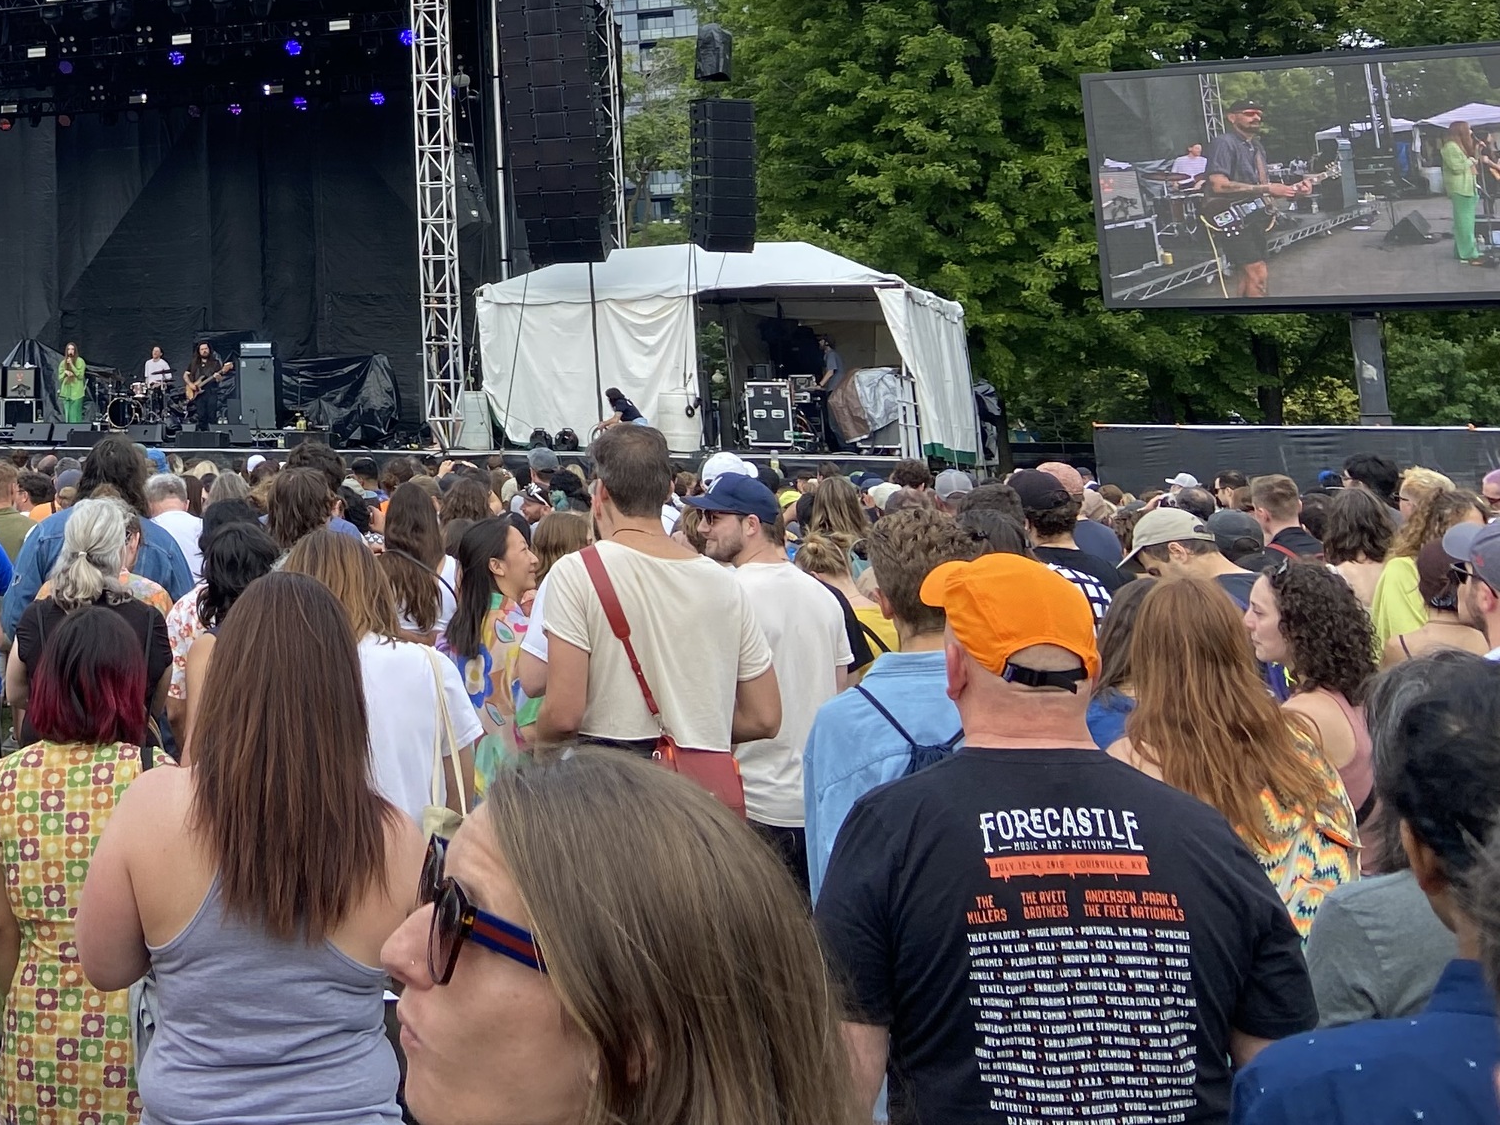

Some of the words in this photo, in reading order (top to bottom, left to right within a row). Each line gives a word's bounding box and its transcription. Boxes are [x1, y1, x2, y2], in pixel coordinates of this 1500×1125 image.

[979, 807, 1145, 854] FORECASTLE
[1013, 840, 1039, 851] MUSIC
[1047, 840, 1062, 850] ART
[1071, 840, 1113, 850] ACTIVISM
[994, 862, 1014, 872] JULY
[1131, 861, 1142, 870] KY
[975, 895, 995, 909] THE
[1020, 891, 1038, 905] THE
[1039, 890, 1067, 904] AVETT
[1084, 890, 1136, 904] ANDERSON
[1170, 894, 1178, 907] &
[966, 908, 1008, 925] KILLERS
[1023, 904, 1069, 920] BROTHERS
[1083, 904, 1102, 917] THE
[1103, 905, 1129, 919] FREE
[1130, 906, 1185, 922] NATIONALS
[1118, 926, 1131, 936] THE
[1132, 928, 1148, 937] MAN
[1000, 944, 1014, 953] THE
[1095, 940, 1113, 950] COLD
[1131, 942, 1148, 951] KIDS
[1154, 943, 1174, 953] MOON
[1101, 968, 1120, 978] WILD
[1171, 983, 1186, 994] JOY
[969, 997, 982, 1006] THE
[982, 997, 1013, 1008] MIDNIGHT
[1082, 1022, 1095, 1031] THE
[1100, 1035, 1113, 1045] THE
[1044, 1051, 1058, 1062] THE
[978, 1061, 991, 1071] THE
[1172, 1088, 1194, 1097] MUSIC
